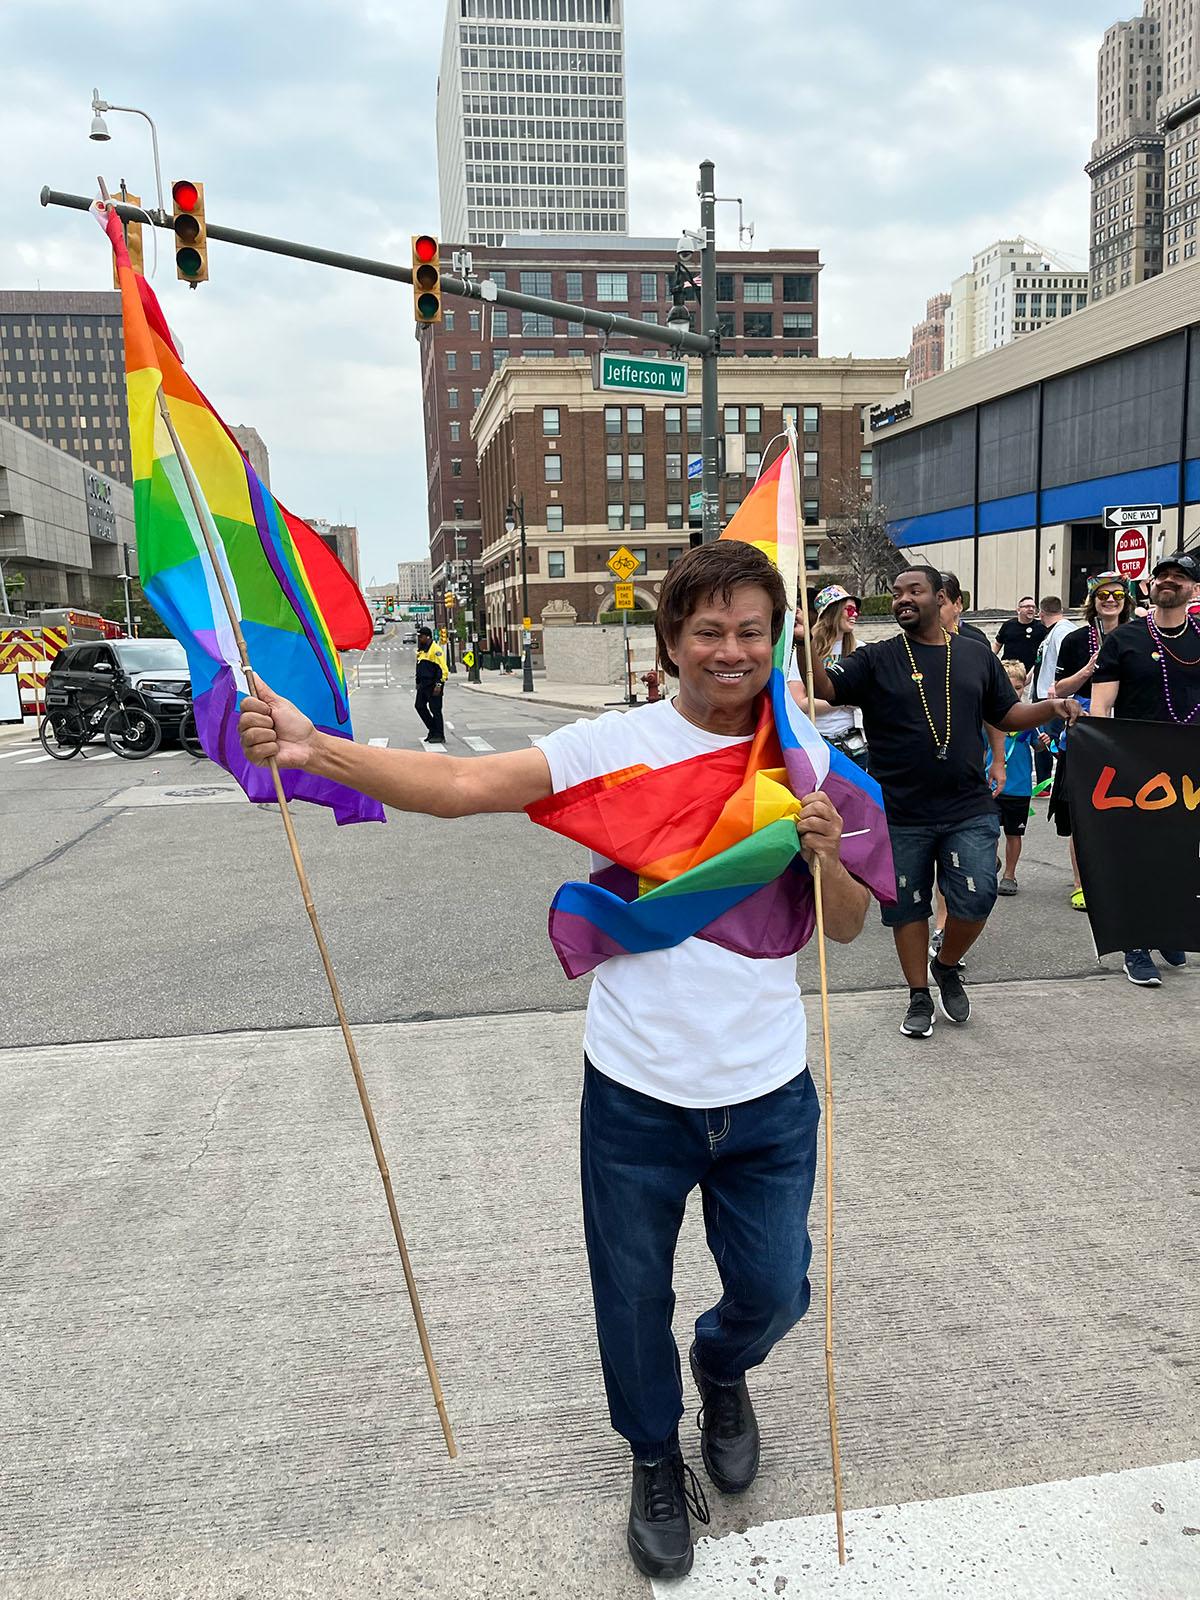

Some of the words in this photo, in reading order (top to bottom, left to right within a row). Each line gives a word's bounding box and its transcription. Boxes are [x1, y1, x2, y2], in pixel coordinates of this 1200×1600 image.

[607, 365, 665, 385] Jefferson
[671, 371, 681, 386] W
[1122, 512, 1137, 521] ONE
[1140, 511, 1156, 519] WAY
[1119, 540, 1129, 548] DO
[1129, 538, 1143, 547] NOT
[1122, 561, 1141, 571] ENTER
